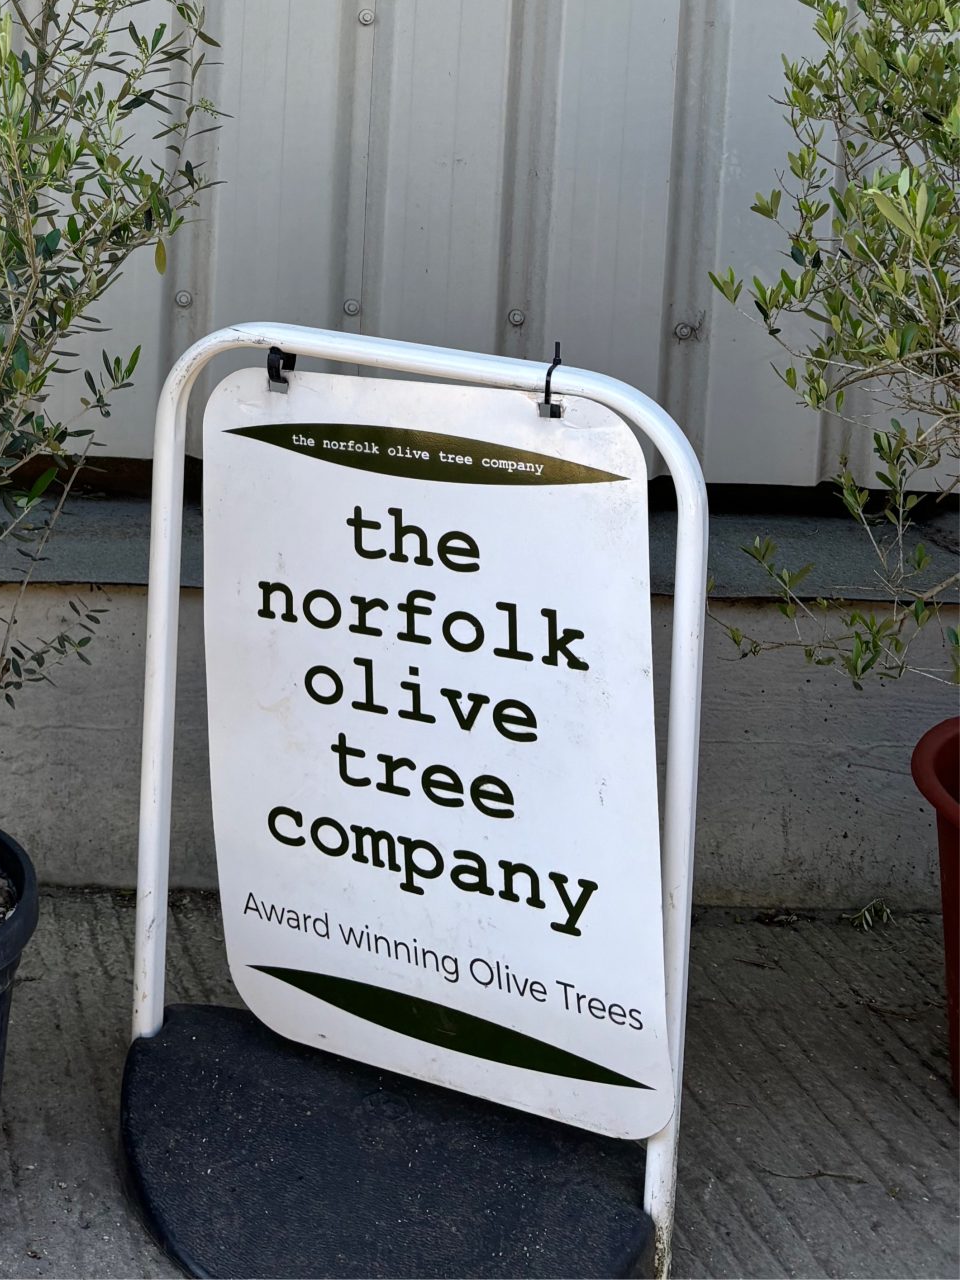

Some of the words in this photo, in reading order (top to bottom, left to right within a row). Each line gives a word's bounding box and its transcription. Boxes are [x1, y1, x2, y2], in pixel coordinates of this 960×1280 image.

[292, 434, 315, 447] the
[323, 439, 380, 454] norfolk
[387, 445, 430, 460] olive
[438, 450, 473, 465] tree
[481, 457, 545, 476] company
[346, 505, 480, 573] the
[257, 580, 590, 672] norfolk
[304, 656, 538, 743] olive
[330, 732, 515, 819] tree
[267, 805, 599, 937] company
[243, 891, 330, 940] Award
[338, 923, 460, 984] winning
[469, 957, 548, 1003] Olive
[555, 979, 644, 1031] Trees
